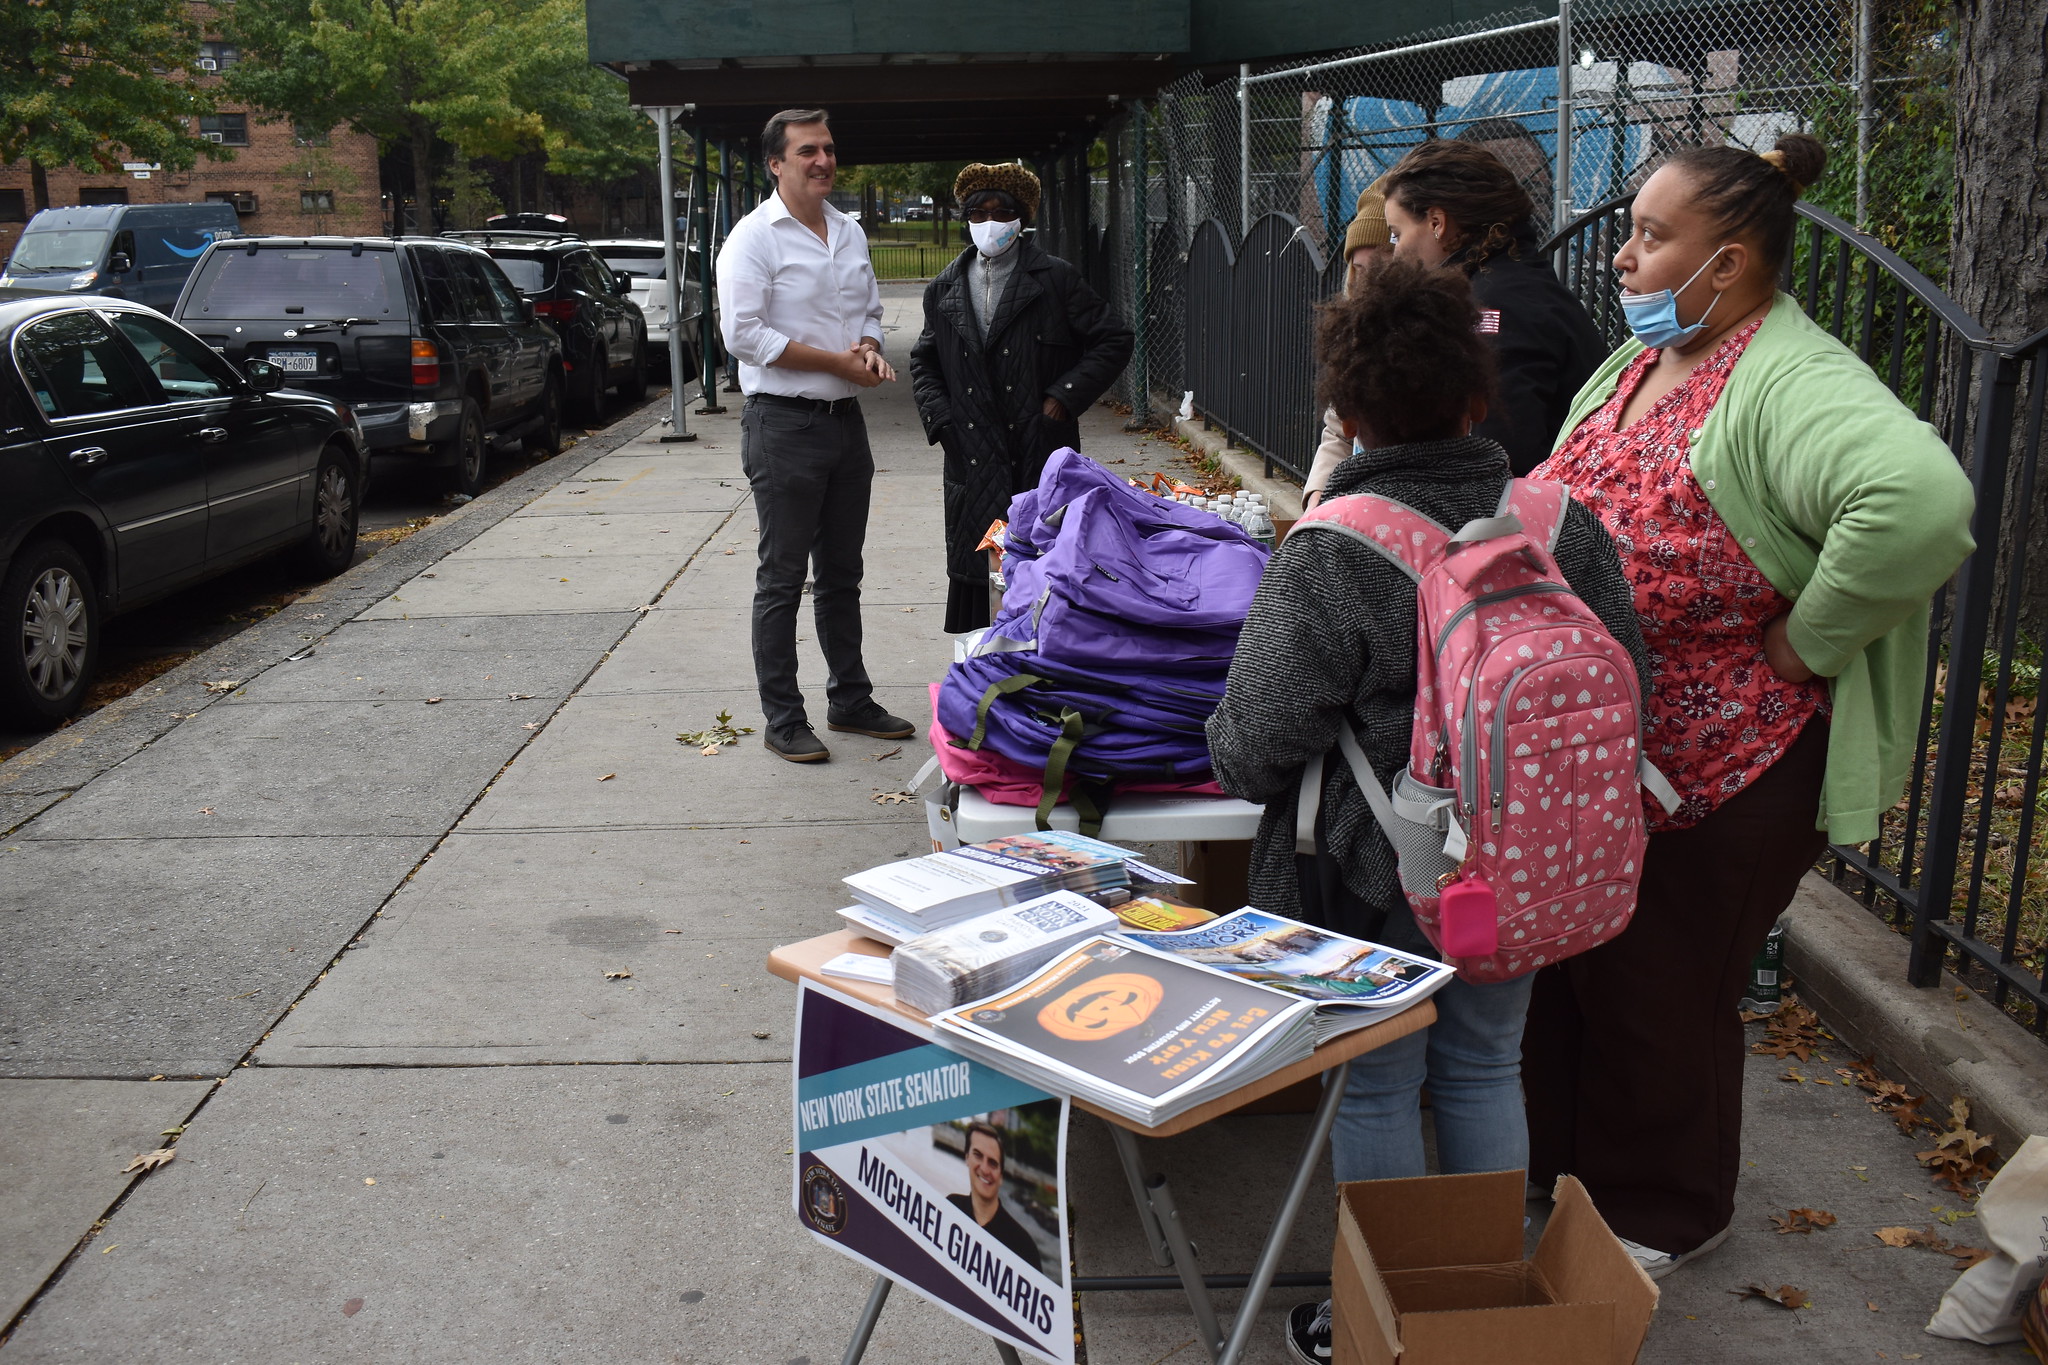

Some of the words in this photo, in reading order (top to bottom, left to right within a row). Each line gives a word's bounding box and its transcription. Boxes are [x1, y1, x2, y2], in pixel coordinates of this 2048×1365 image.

[214, 229, 232, 241] prime
[1046, 901, 1083, 921] NEW
[1066, 901, 1091, 912] 2021
[1018, 911, 1057, 930] CITY
[1032, 906, 1071, 928] YORK
[1200, 917, 1248, 936] KNOW
[1204, 922, 1267, 946] YORK
[1766, 942, 1779, 951] 24
[1191, 1009, 1231, 1035] New
[1230, 1007, 1269, 1029] Get
[1207, 1032, 1237, 1048] To
[1148, 1037, 1198, 1065] York
[1160, 1049, 1213, 1079] Know
[800, 1097, 829, 1132] NEW
[828, 1089, 866, 1126] YORK
[864, 1077, 905, 1117] STATE
[904, 1061, 971, 1109] SENATOR
[804, 1169, 816, 1184] NEW
[815, 1167, 831, 1180] YORK
[813, 1216, 836, 1232] SENATE
[857, 1145, 944, 1252] MICHAEL
[948, 1222, 1056, 1336] GIANARIS
